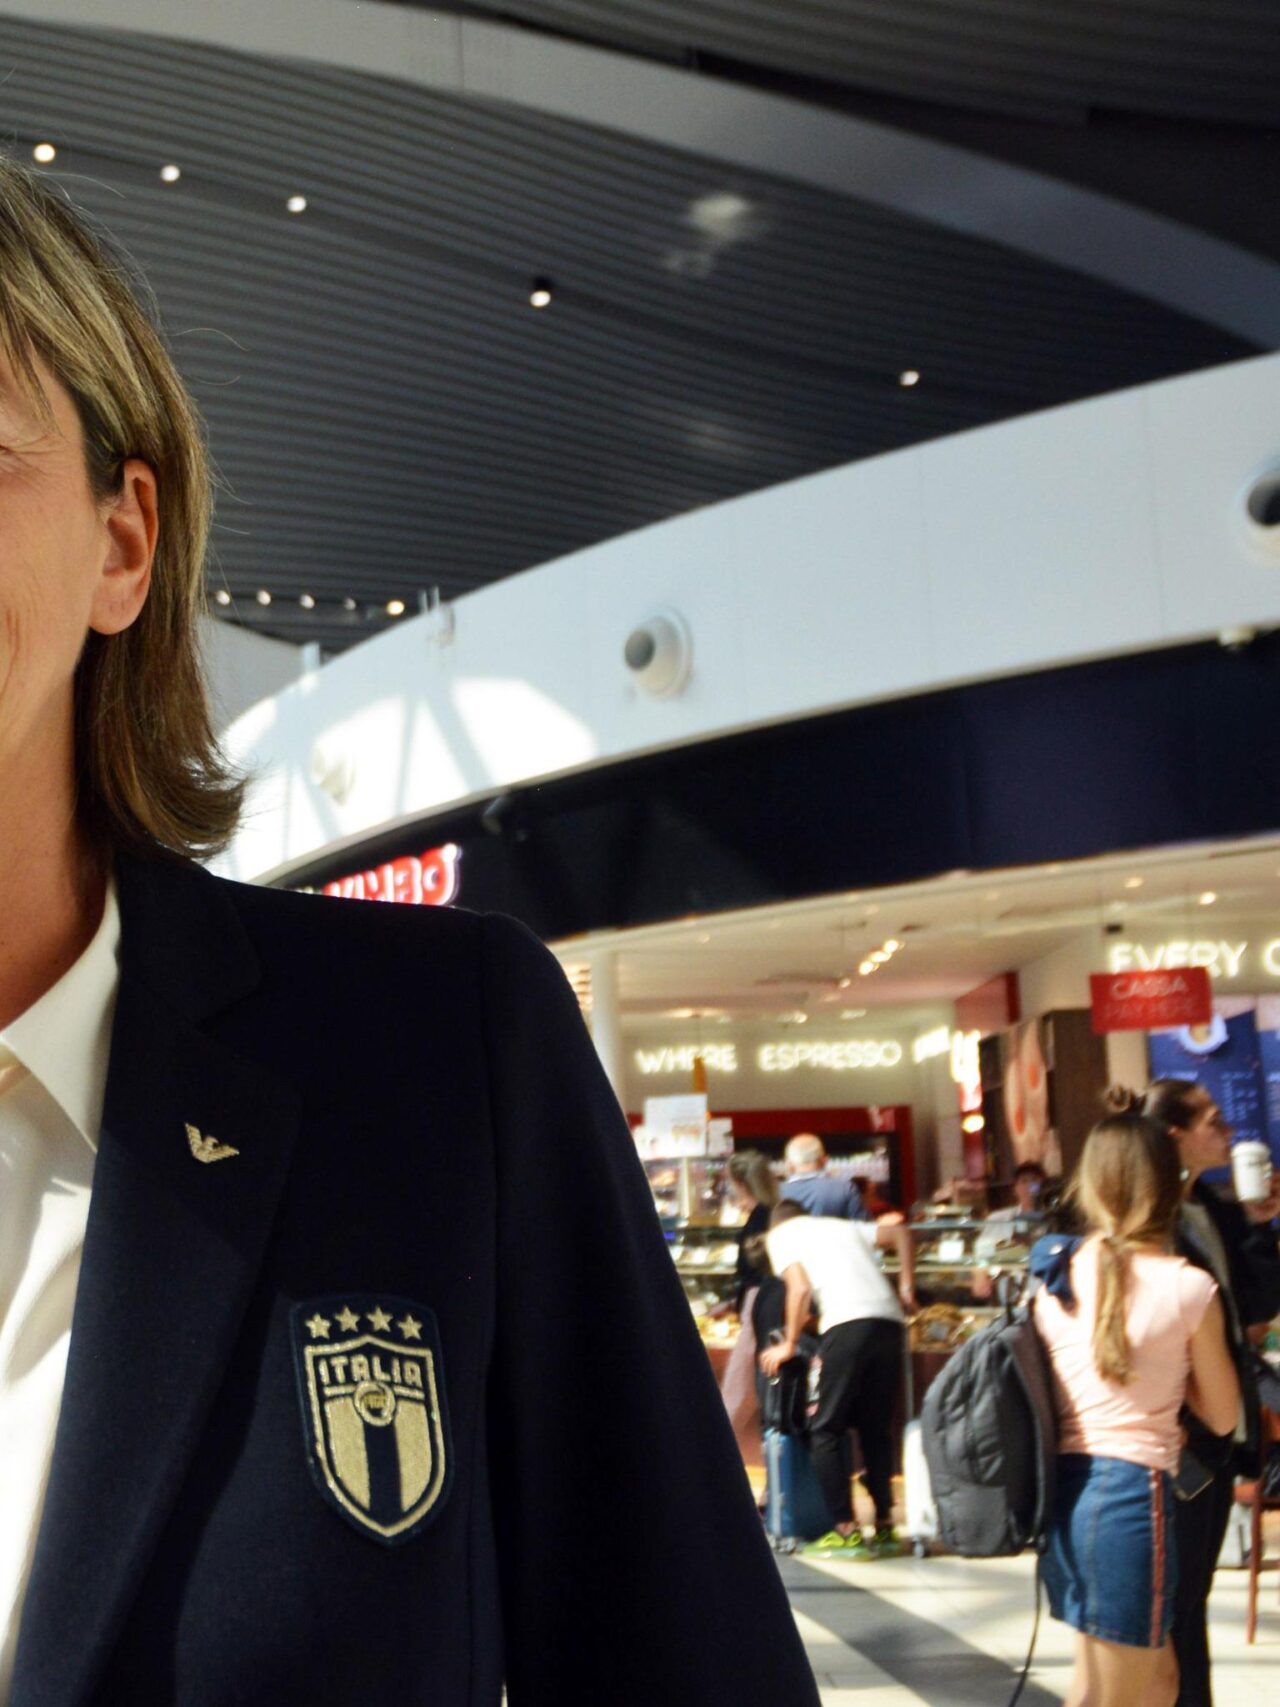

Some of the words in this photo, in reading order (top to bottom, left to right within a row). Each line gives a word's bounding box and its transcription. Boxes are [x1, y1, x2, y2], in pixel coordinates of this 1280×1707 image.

[1108, 940, 1248, 977] EVERY
[1111, 976, 1190, 1000] CASSA
[757, 1040, 902, 1073] ESPRESSO
[318, 1354, 423, 1387] ITALIA
